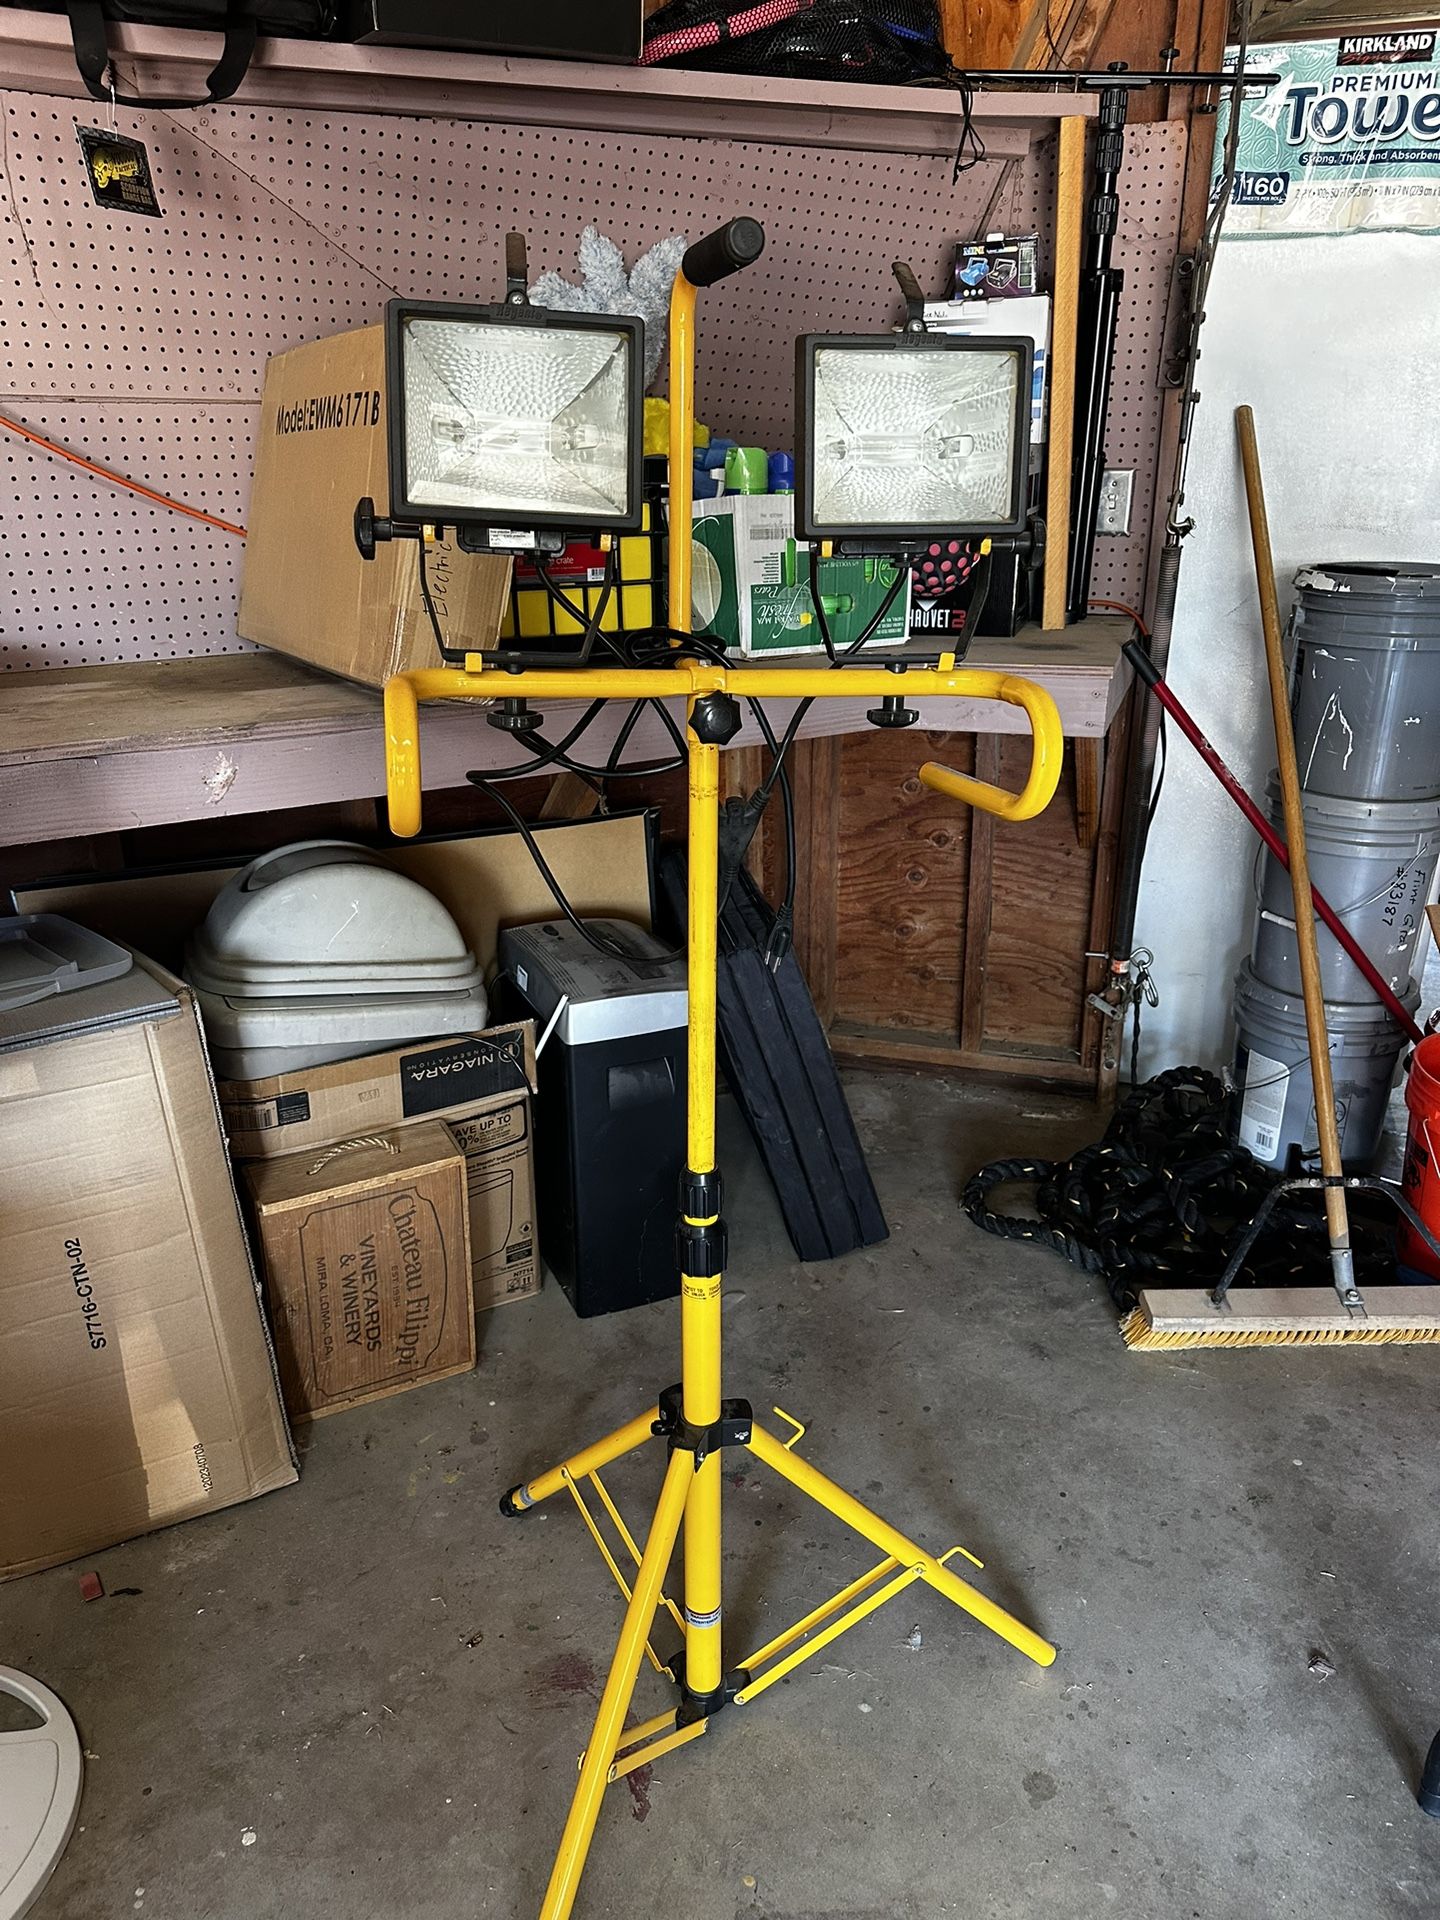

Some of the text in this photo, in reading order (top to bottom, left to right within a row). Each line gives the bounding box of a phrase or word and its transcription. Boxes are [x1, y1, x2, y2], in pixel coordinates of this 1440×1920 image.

[1343, 34, 1433, 54] KIRKLAND
[1246, 177, 1285, 196] 160
[555, 556, 575, 565] crate
[429, 543, 453, 618] Electric
[909, 608, 951, 629] HAUVET
[410, 1052, 495, 1082] NIAGARA
[453, 1124, 477, 1139] AVE
[479, 1119, 495, 1131] UP
[496, 1113, 511, 1125] TO
[316, 1256, 328, 1292] MIRA
[387, 1193, 430, 1367] Chateau Filippi
[64, 1237, 107, 1350] S7716-CTN-02
[339, 1253, 362, 1346] & WINERY
[359, 1233, 382, 1352] VINEYARDS
